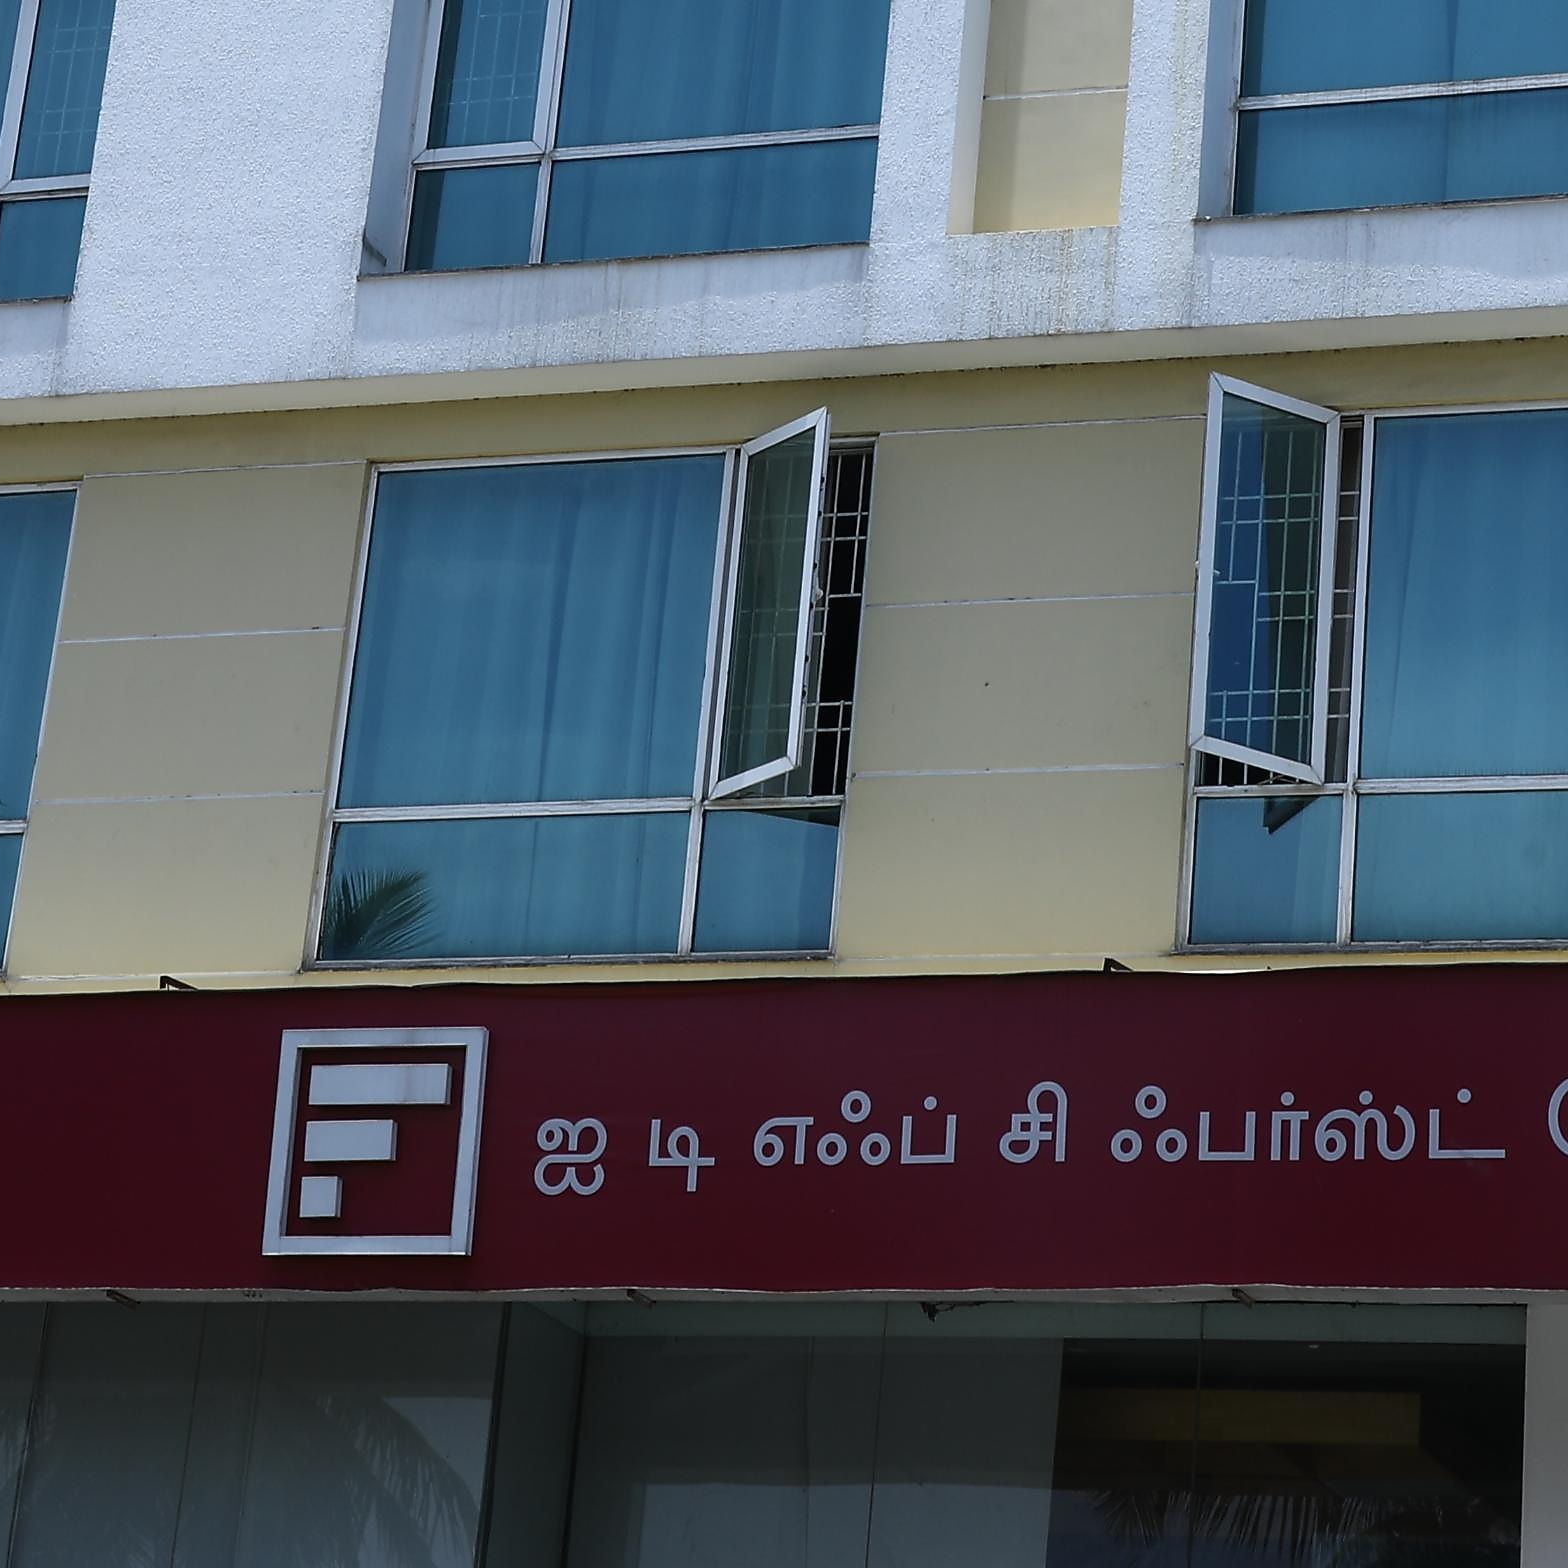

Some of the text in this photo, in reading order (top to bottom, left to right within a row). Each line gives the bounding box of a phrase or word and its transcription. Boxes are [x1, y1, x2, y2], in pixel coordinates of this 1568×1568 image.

[534, 1117, 608, 1196] ஐ
[648, 1119, 716, 1192] டி
[753, 1090, 957, 1167] எஃப்
[999, 1081, 1068, 1164] சி
[1110, 1085, 1506, 1163] ஃபர்ஸ்ட்
